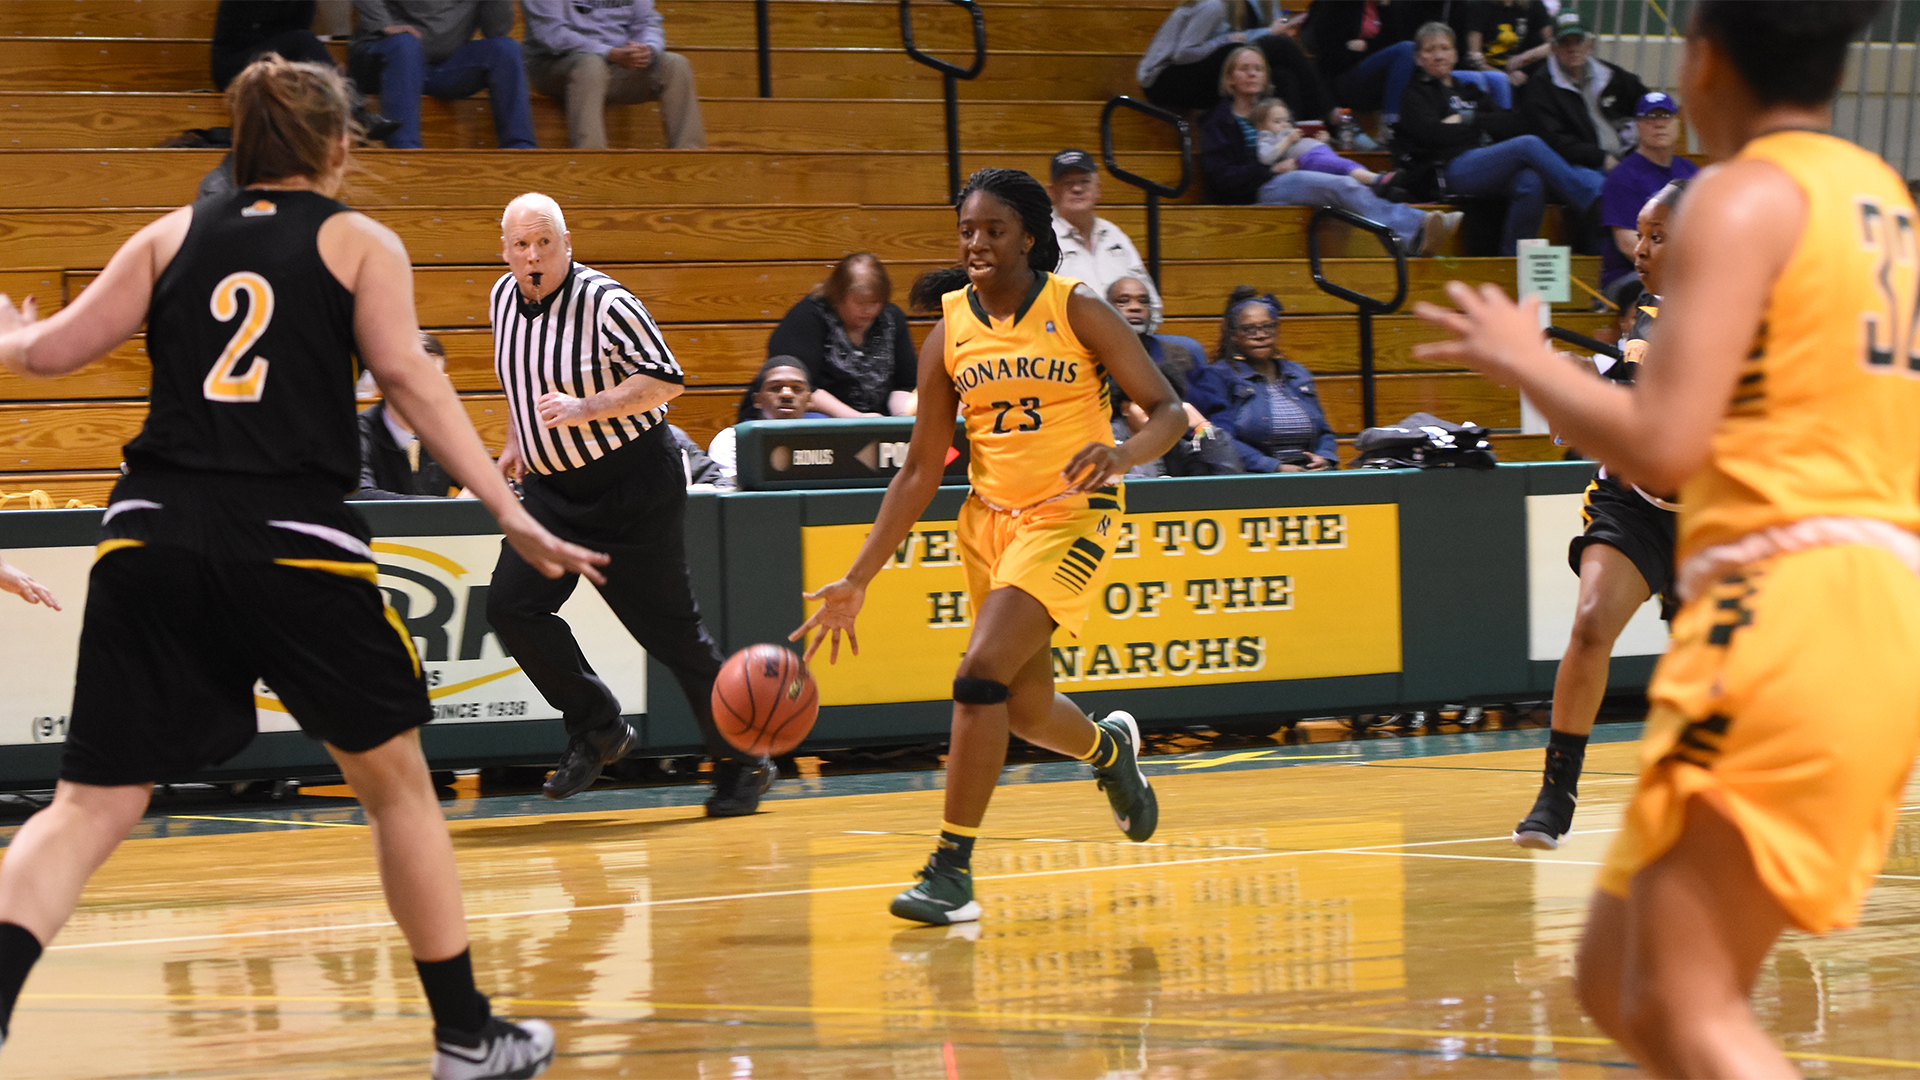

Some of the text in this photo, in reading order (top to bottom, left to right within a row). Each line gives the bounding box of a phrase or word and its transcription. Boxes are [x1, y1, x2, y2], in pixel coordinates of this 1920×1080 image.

[203, 271, 275, 403] 2
[991, 396, 1043, 434] 23
[793, 449, 834, 466] BONUS
[1153, 519, 1225, 556] TO
[1239, 514, 1347, 552] THE
[1104, 575, 1294, 620] OF THE
[1051, 636, 1266, 683] NARCHS
[432, 700, 529, 719] SINCE 1938
